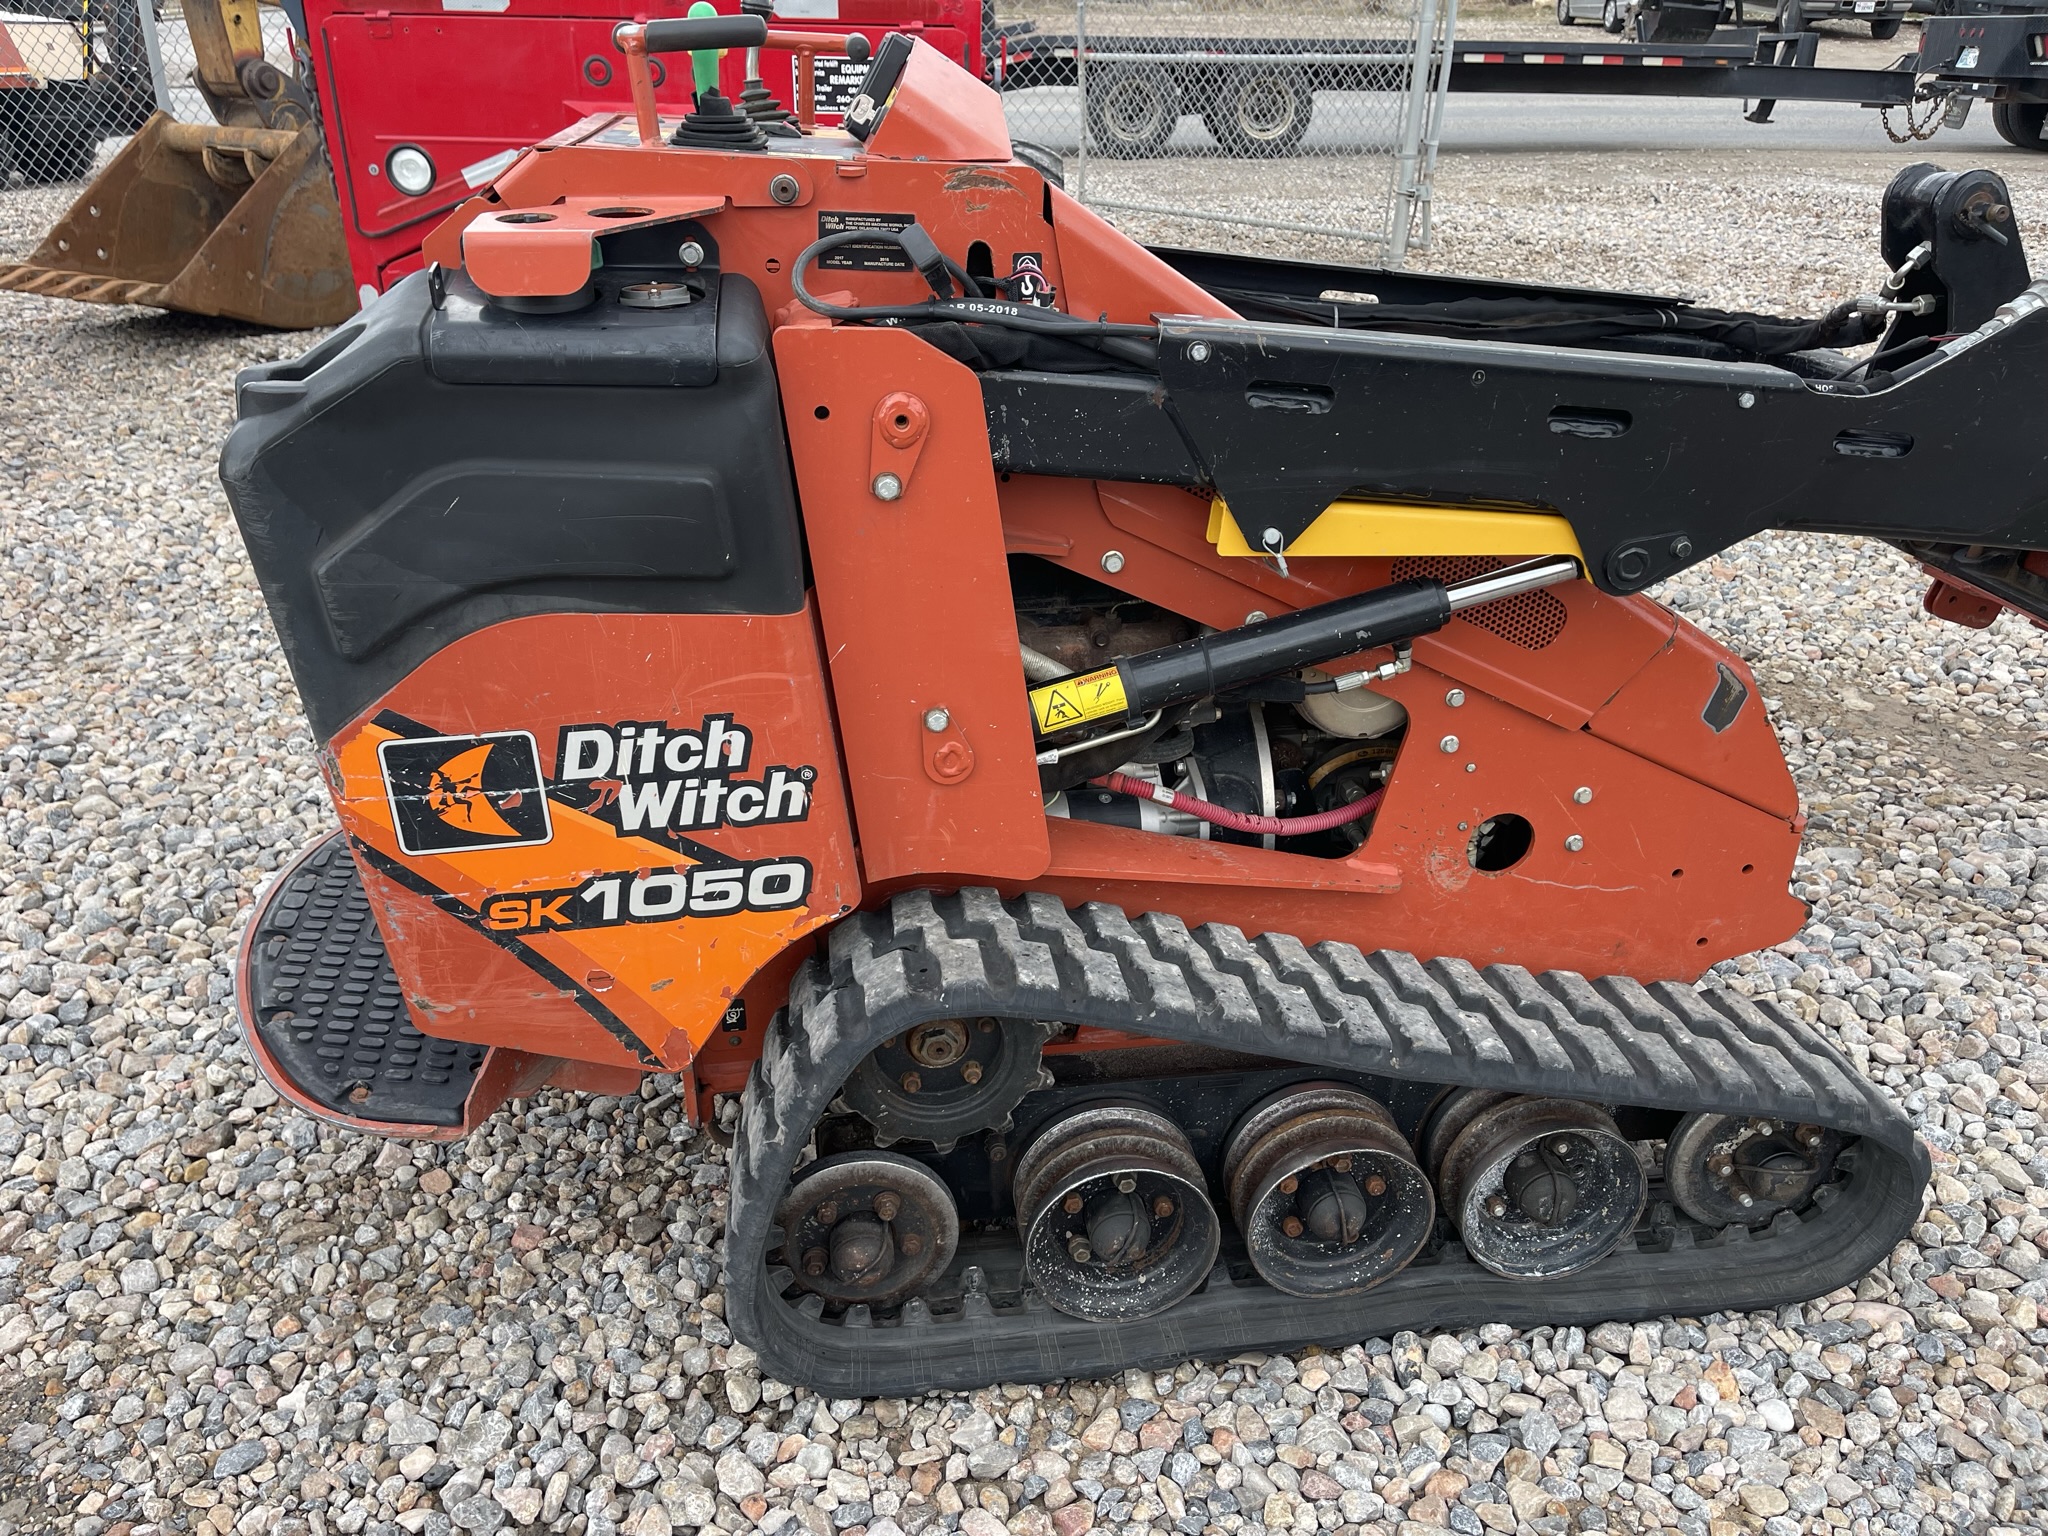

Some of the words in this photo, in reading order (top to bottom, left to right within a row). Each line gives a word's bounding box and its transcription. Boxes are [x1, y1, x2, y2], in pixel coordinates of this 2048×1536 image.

[816, 84, 832, 92] Trailer
[969, 303, 1018, 316] 05-2018
[1083, 669, 1117, 683] WARNING
[562, 720, 746, 780] Ditch
[489, 895, 574, 930] SK
[580, 863, 805, 920] 1050
